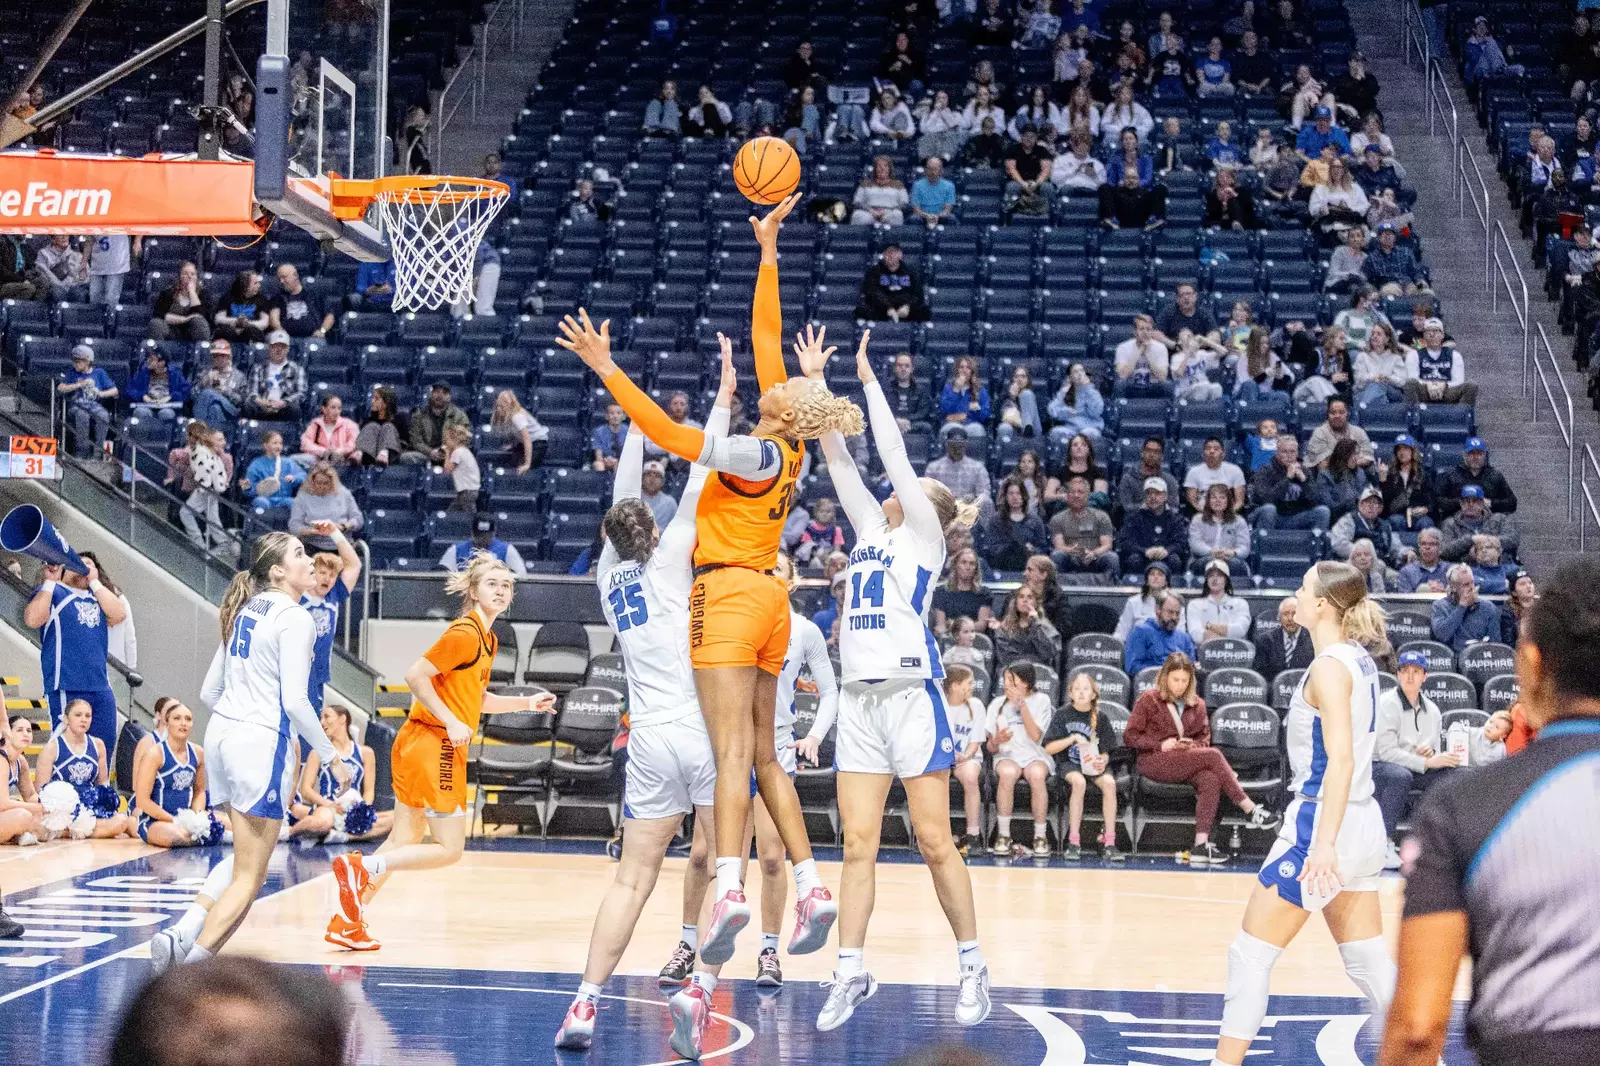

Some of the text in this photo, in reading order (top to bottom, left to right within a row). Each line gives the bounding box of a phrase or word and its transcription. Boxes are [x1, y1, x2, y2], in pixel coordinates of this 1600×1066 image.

[0, 182, 111, 216] e Farm
[25, 458, 43, 475] 31
[847, 546, 895, 569] RIGHAM
[851, 571, 885, 609] 14
[608, 583, 649, 633] 25
[691, 583, 705, 648] COWGIRLS
[849, 614, 886, 631] YOUNG
[1256, 621, 1281, 629] SAPP
[230, 615, 257, 660] 15
[1072, 648, 1121, 660] SAPPHIRE
[1204, 650, 1254, 660] SAPPHIRE
[1428, 658, 1452, 667] HIRE
[1464, 658, 1514, 669] SAPPHIRE
[592, 667, 627, 679] SAPPH
[1211, 682, 1264, 696] SAPPHIRE
[1420, 689, 1469, 700] APPHIRE
[1489, 689, 1518, 701] SAPP
[566, 701, 621, 714] SAPPHIRE
[1368, 683, 1376, 733] 1
[1216, 718, 1272, 732] SAPPHIRE
[440, 738, 454, 791] COWGIRLS
